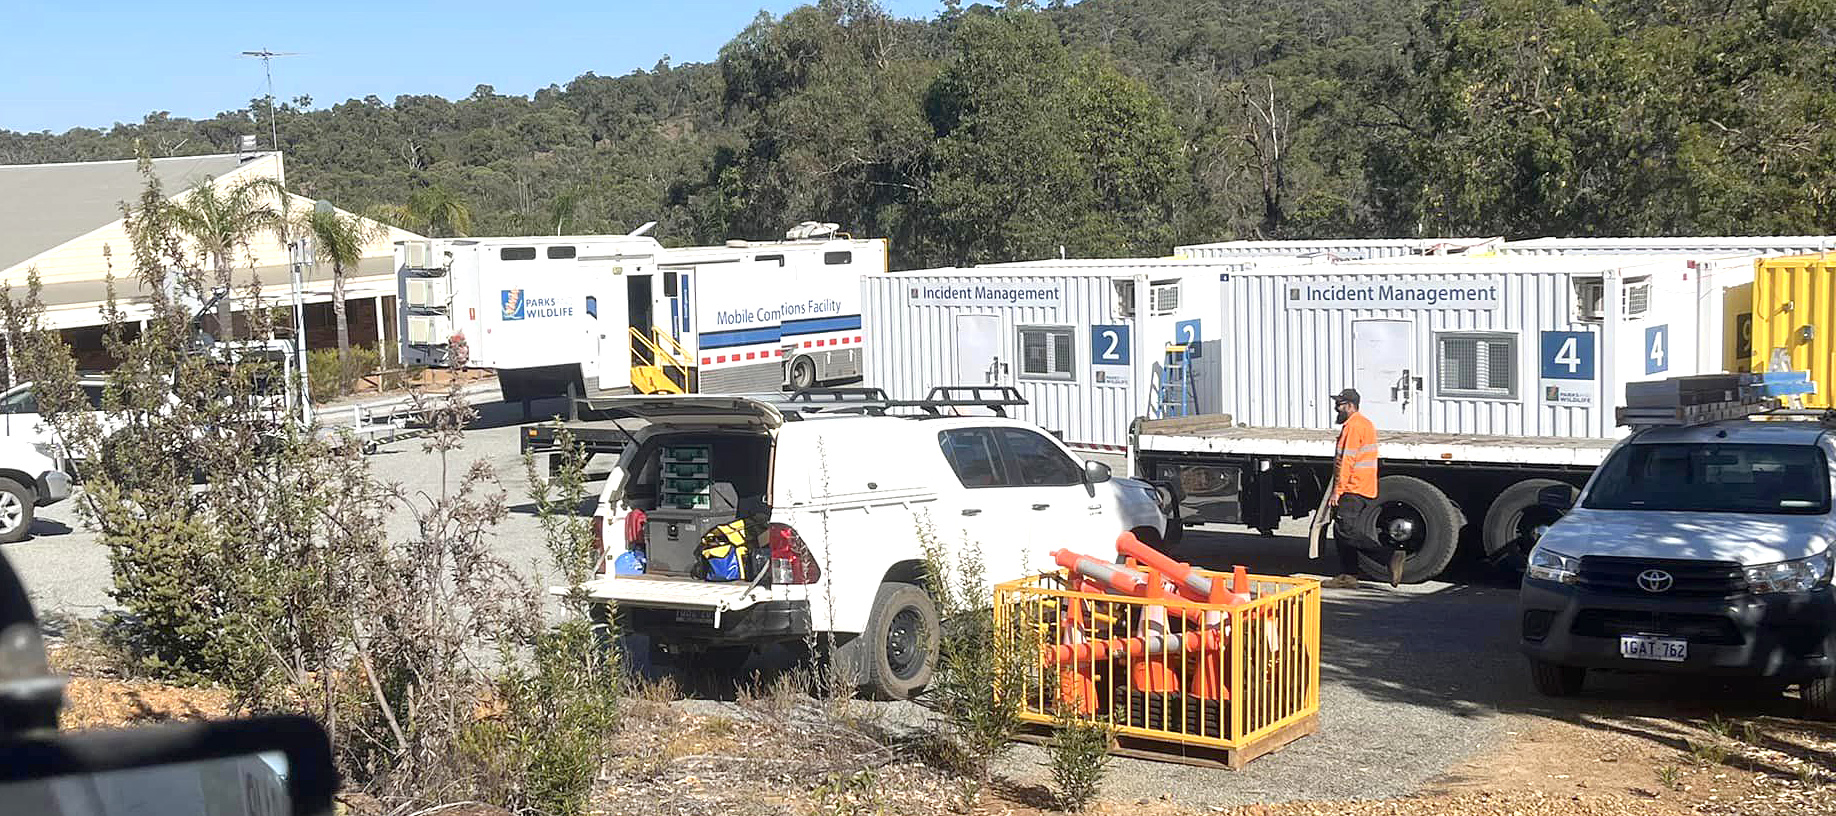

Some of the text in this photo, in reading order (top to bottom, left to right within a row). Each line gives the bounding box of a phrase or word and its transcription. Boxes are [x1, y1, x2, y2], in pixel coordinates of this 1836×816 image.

[526, 298, 556, 308] PARKS
[923, 286, 1059, 303] Incident Management
[1307, 285, 1497, 305] Incident Management
[526, 307, 574, 318] WILDLIFE
[717, 309, 754, 325] Mobile
[808, 299, 841, 314] Facility
[1102, 330, 1120, 360] 2
[1554, 337, 1581, 373] 4
[1650, 331, 1664, 367] 4
[1624, 641, 1685, 658] 1GAT 762
